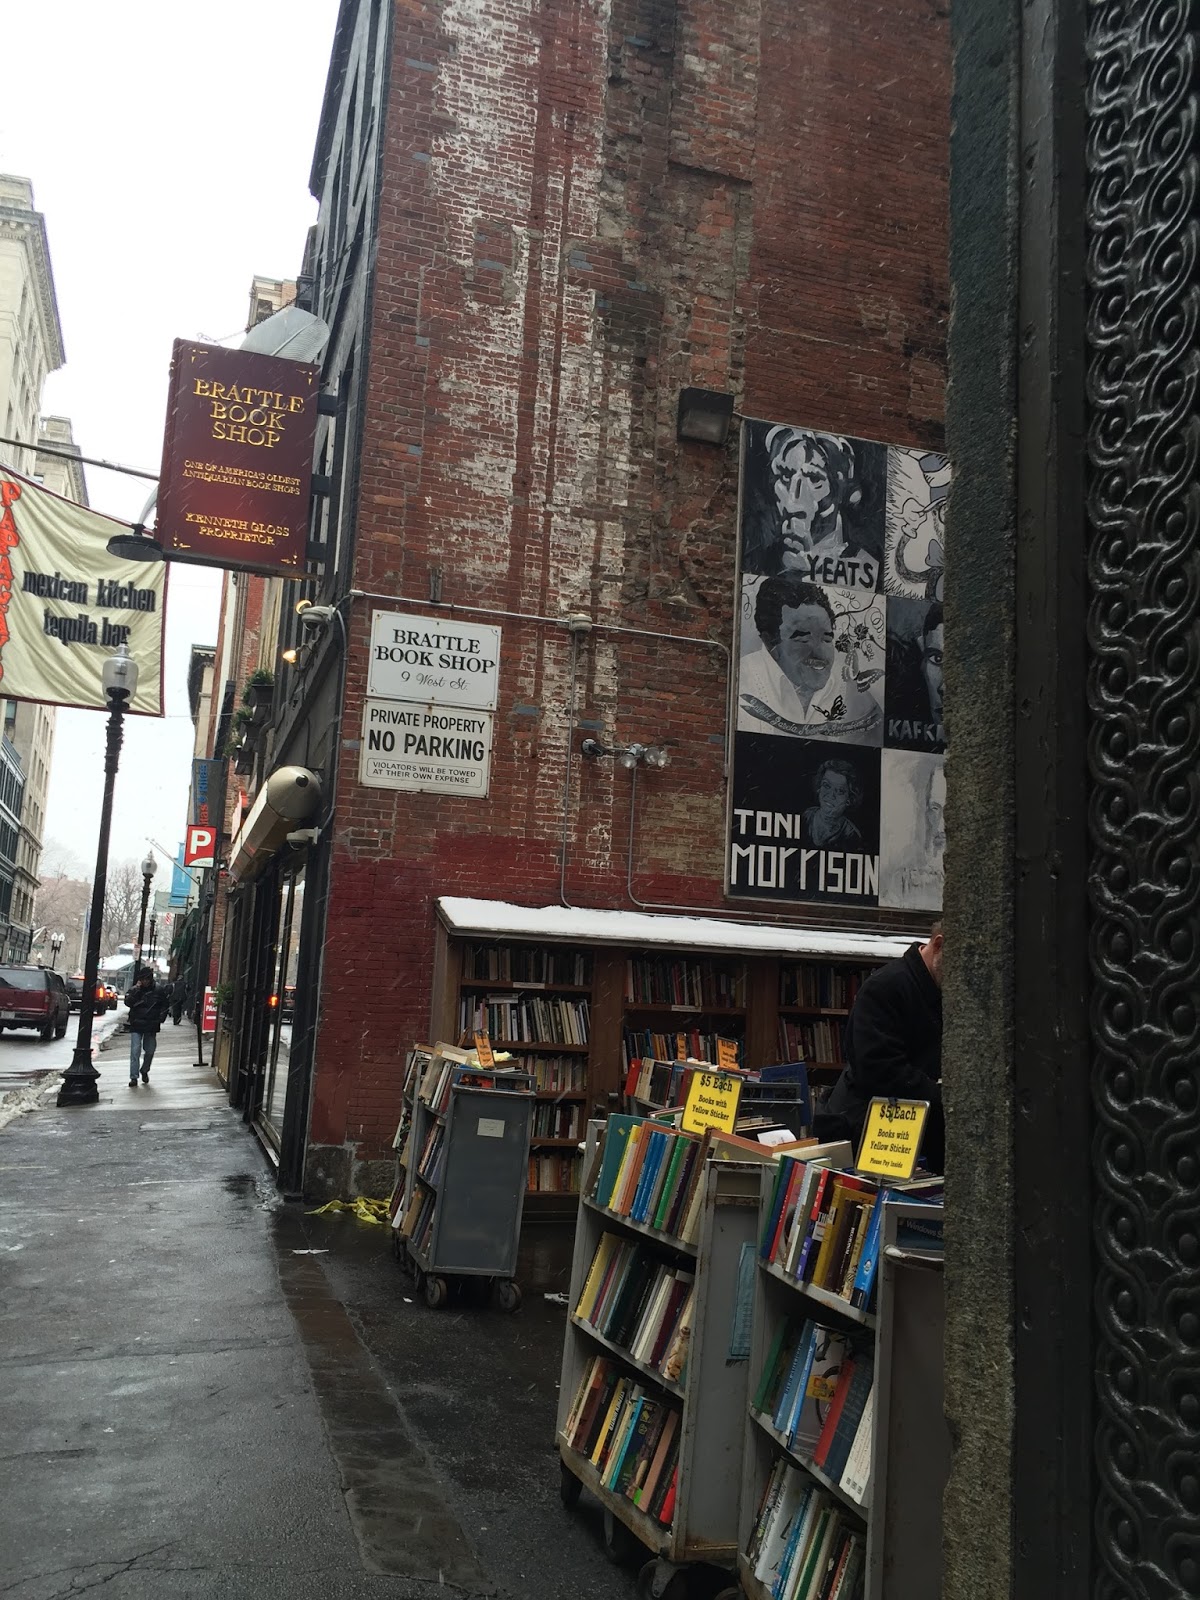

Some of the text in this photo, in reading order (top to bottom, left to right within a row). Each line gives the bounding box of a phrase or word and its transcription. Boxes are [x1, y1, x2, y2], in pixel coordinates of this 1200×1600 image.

[193, 378, 305, 413] BRATTLE
[210, 401, 286, 430] BOOK
[212, 421, 280, 448] SHOP
[182, 469, 300, 496] ANTIQUARIAN BOOK SHOPS
[184, 460, 301, 486] ONE OF AMERICA'S OLDEST
[186, 512, 290, 537] KENNETH GLOSS
[199, 526, 275, 545] PROPRIETOR
[807, 554, 874, 589] YEATS
[21, 571, 156, 612] mexican kitchen
[43, 607, 131, 647] tequila bar
[392, 628, 481, 654] BRATTLE
[376, 645, 496, 674] BOOK SHOP
[401, 670, 471, 691] 9 West St.
[370, 708, 486, 734] PRIVATE PROPERTY
[368, 729, 485, 762] NO PARKING
[372, 761, 477, 778] VIOLATORS WILL BE TOWED
[386, 769, 410, 778] THEIR
[412, 772, 433, 780] OWN
[434, 774, 470, 784] EXPENSE
[734, 808, 801, 839] TONI
[190, 829, 212, 855] P
[700, 1074, 733, 1092] $5 Each
[691, 1104, 730, 1121] Yellow Sticker
[698, 1094, 728, 1109] Books with
[879, 1104, 917, 1121] $5 Each
[870, 1140, 912, 1155] Yellow Sticker
[877, 1128, 910, 1141] Books with
[906, 1220, 937, 1237] Windows
